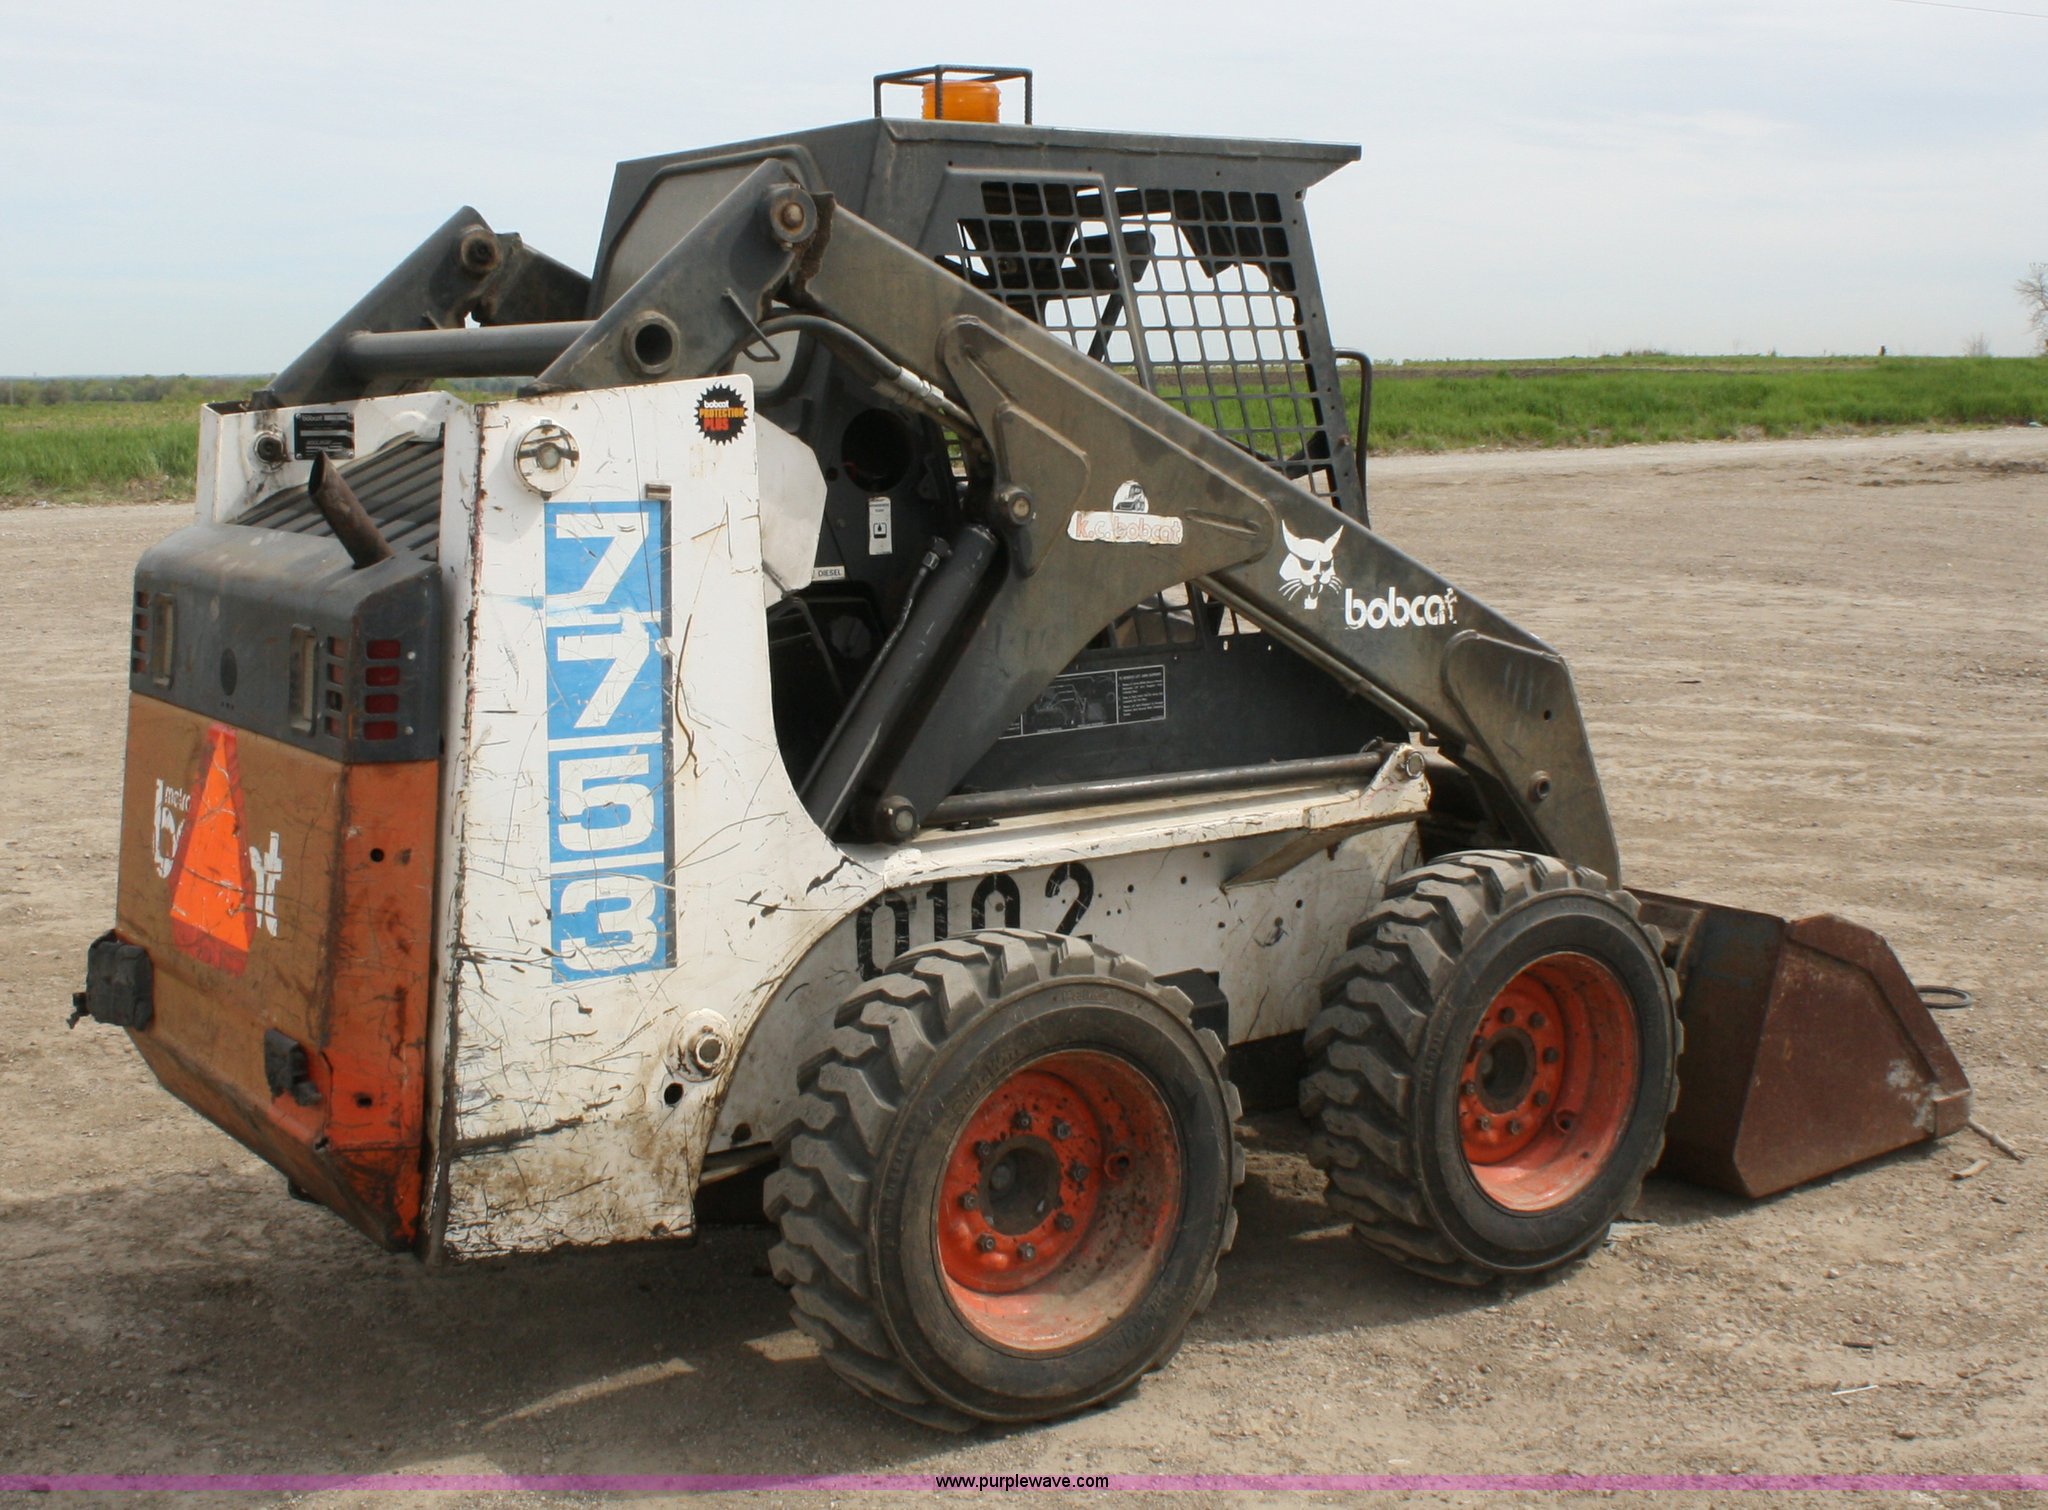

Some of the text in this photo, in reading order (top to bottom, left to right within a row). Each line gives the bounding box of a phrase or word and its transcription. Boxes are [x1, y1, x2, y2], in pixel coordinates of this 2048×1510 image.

[699, 407, 745, 418] PROTECTION
[703, 418, 729, 431] PLUS
[1344, 586, 1458, 630] bobcat
[544, 512, 658, 972] 7753
